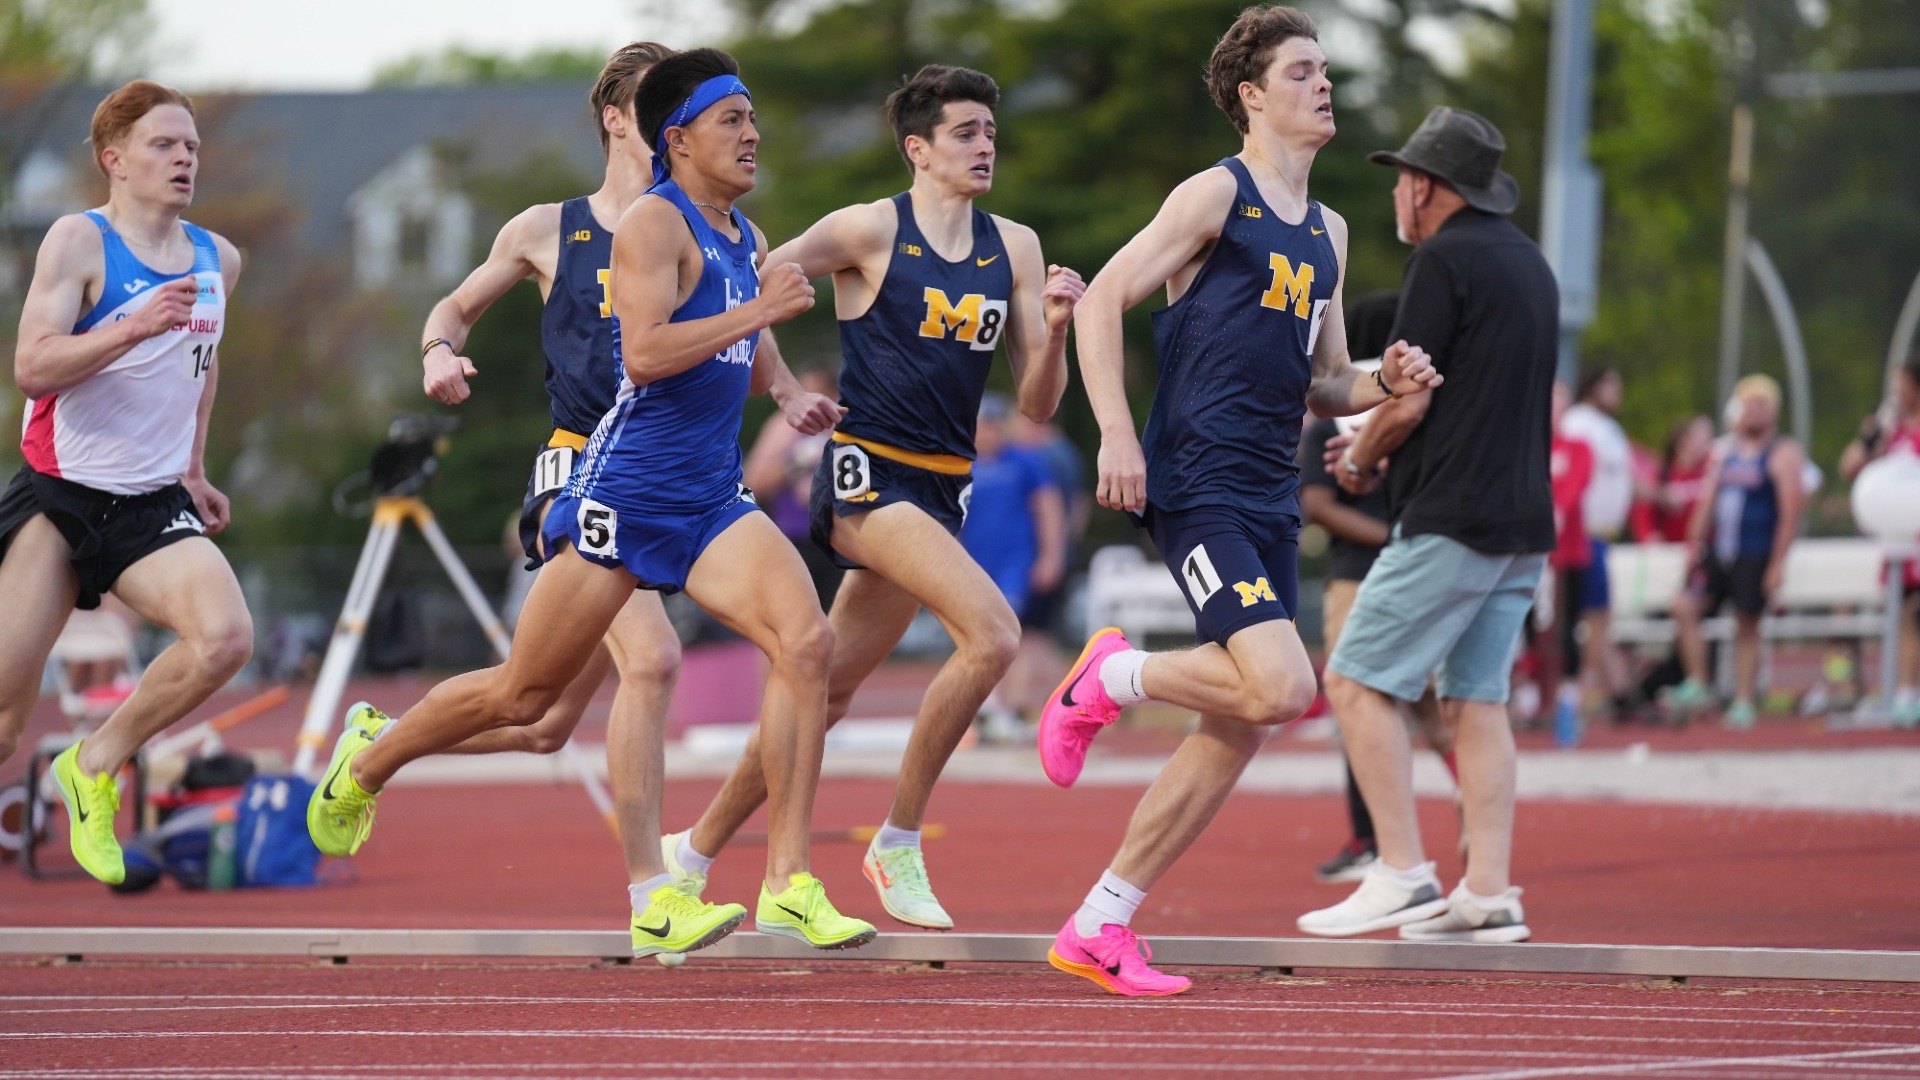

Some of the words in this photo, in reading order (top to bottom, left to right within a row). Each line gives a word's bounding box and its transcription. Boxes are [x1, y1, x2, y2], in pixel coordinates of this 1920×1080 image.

[1260, 252, 1314, 320] M
[170, 318, 218, 334] EUBLIC
[919, 286, 986, 343] M
[977, 309, 1001, 345] 8
[192, 344, 213, 378] 14
[540, 450, 561, 490] 11
[836, 454, 863, 491] 8
[584, 509, 610, 549] 5
[1188, 555, 1211, 596] 1
[1232, 577, 1277, 608] M
